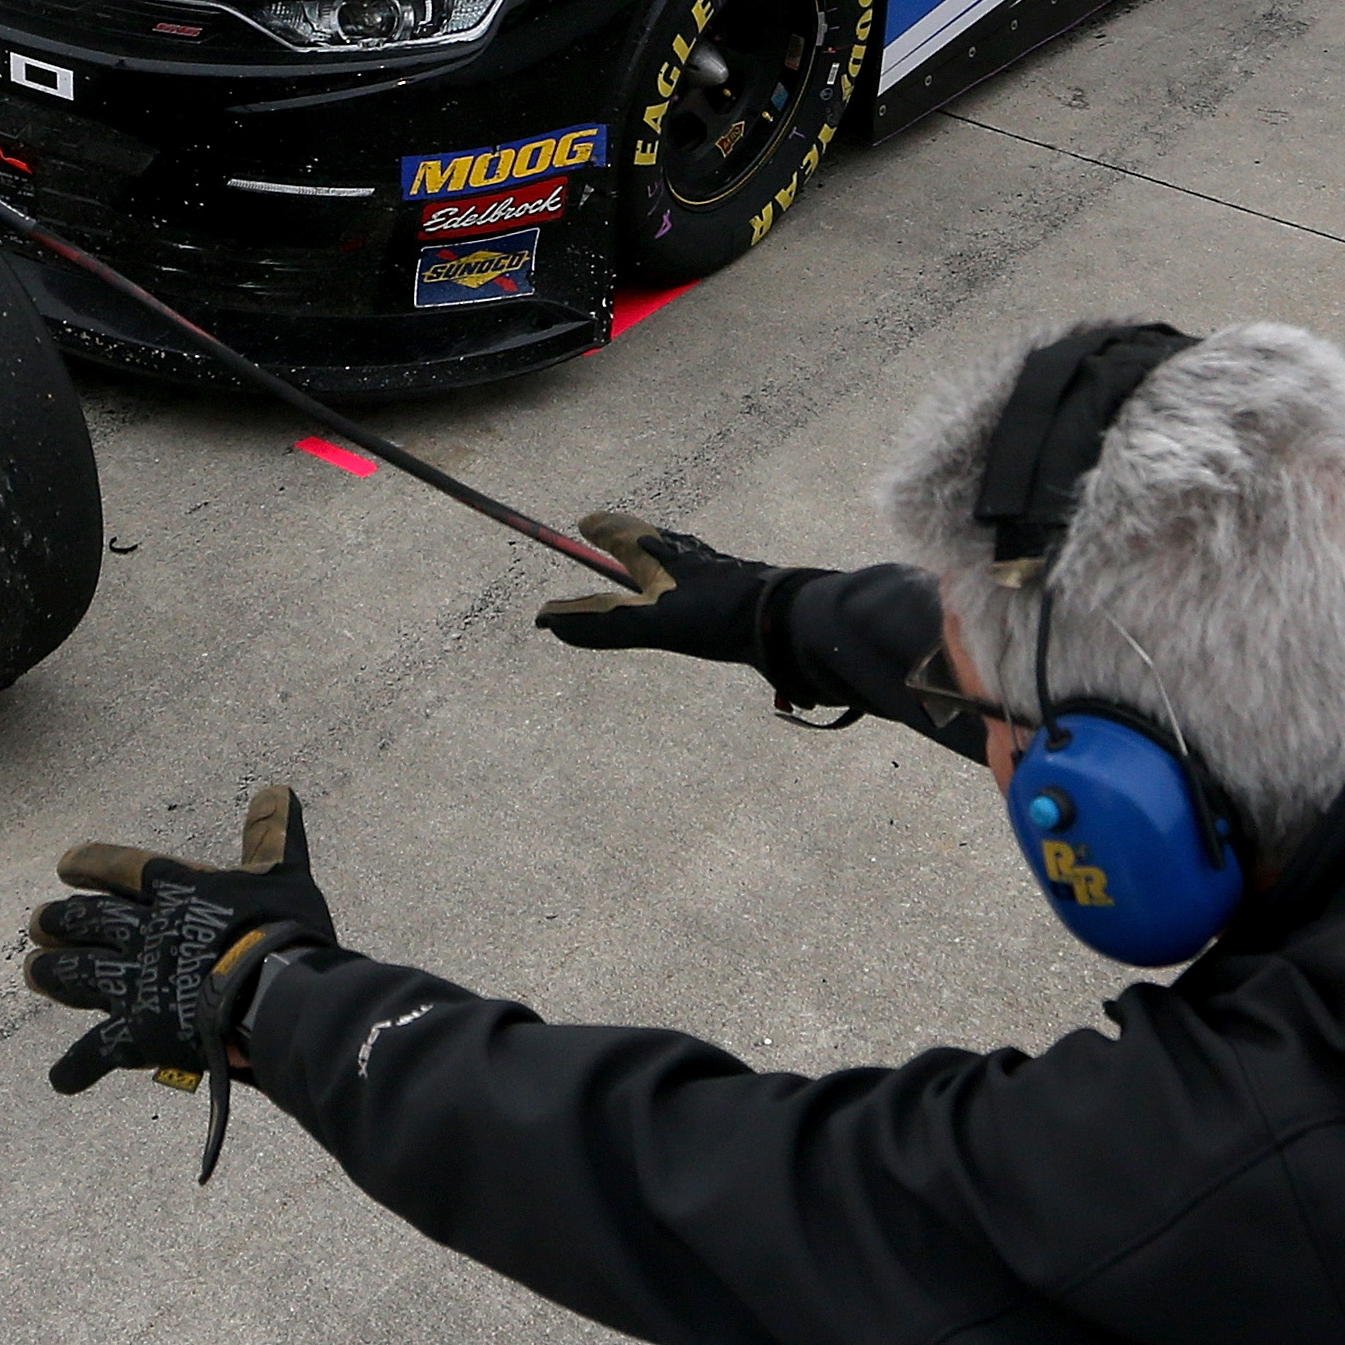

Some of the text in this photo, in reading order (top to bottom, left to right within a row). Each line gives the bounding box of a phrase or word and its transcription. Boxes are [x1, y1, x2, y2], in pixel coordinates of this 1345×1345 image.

[409, 128, 599, 195] MOOG
[421, 185, 563, 235] Edelbrock
[423, 249, 530, 284] SUNOCO
